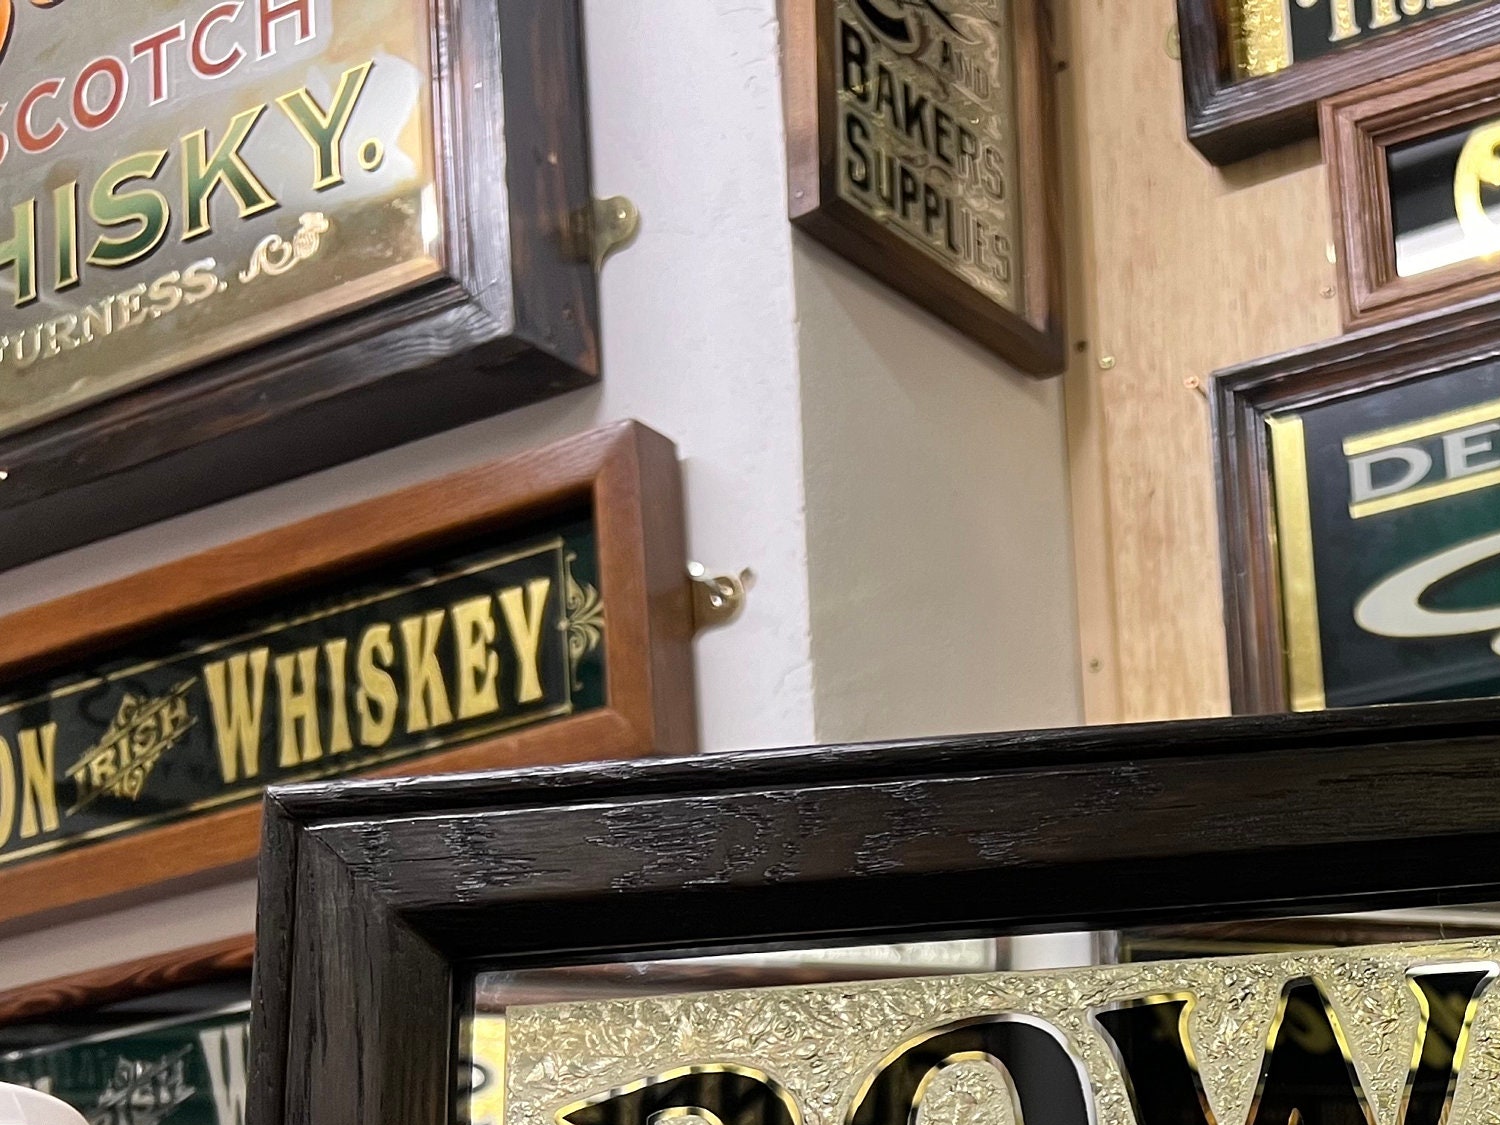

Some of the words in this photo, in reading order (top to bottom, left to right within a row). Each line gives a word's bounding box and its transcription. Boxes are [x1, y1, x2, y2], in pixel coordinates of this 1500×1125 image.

[0, 0, 318, 167] COTCH
[840, 19, 1005, 201] BAKERS
[845, 111, 1011, 284] SUPPLIES
[205, 577, 551, 784] WHISKEY
